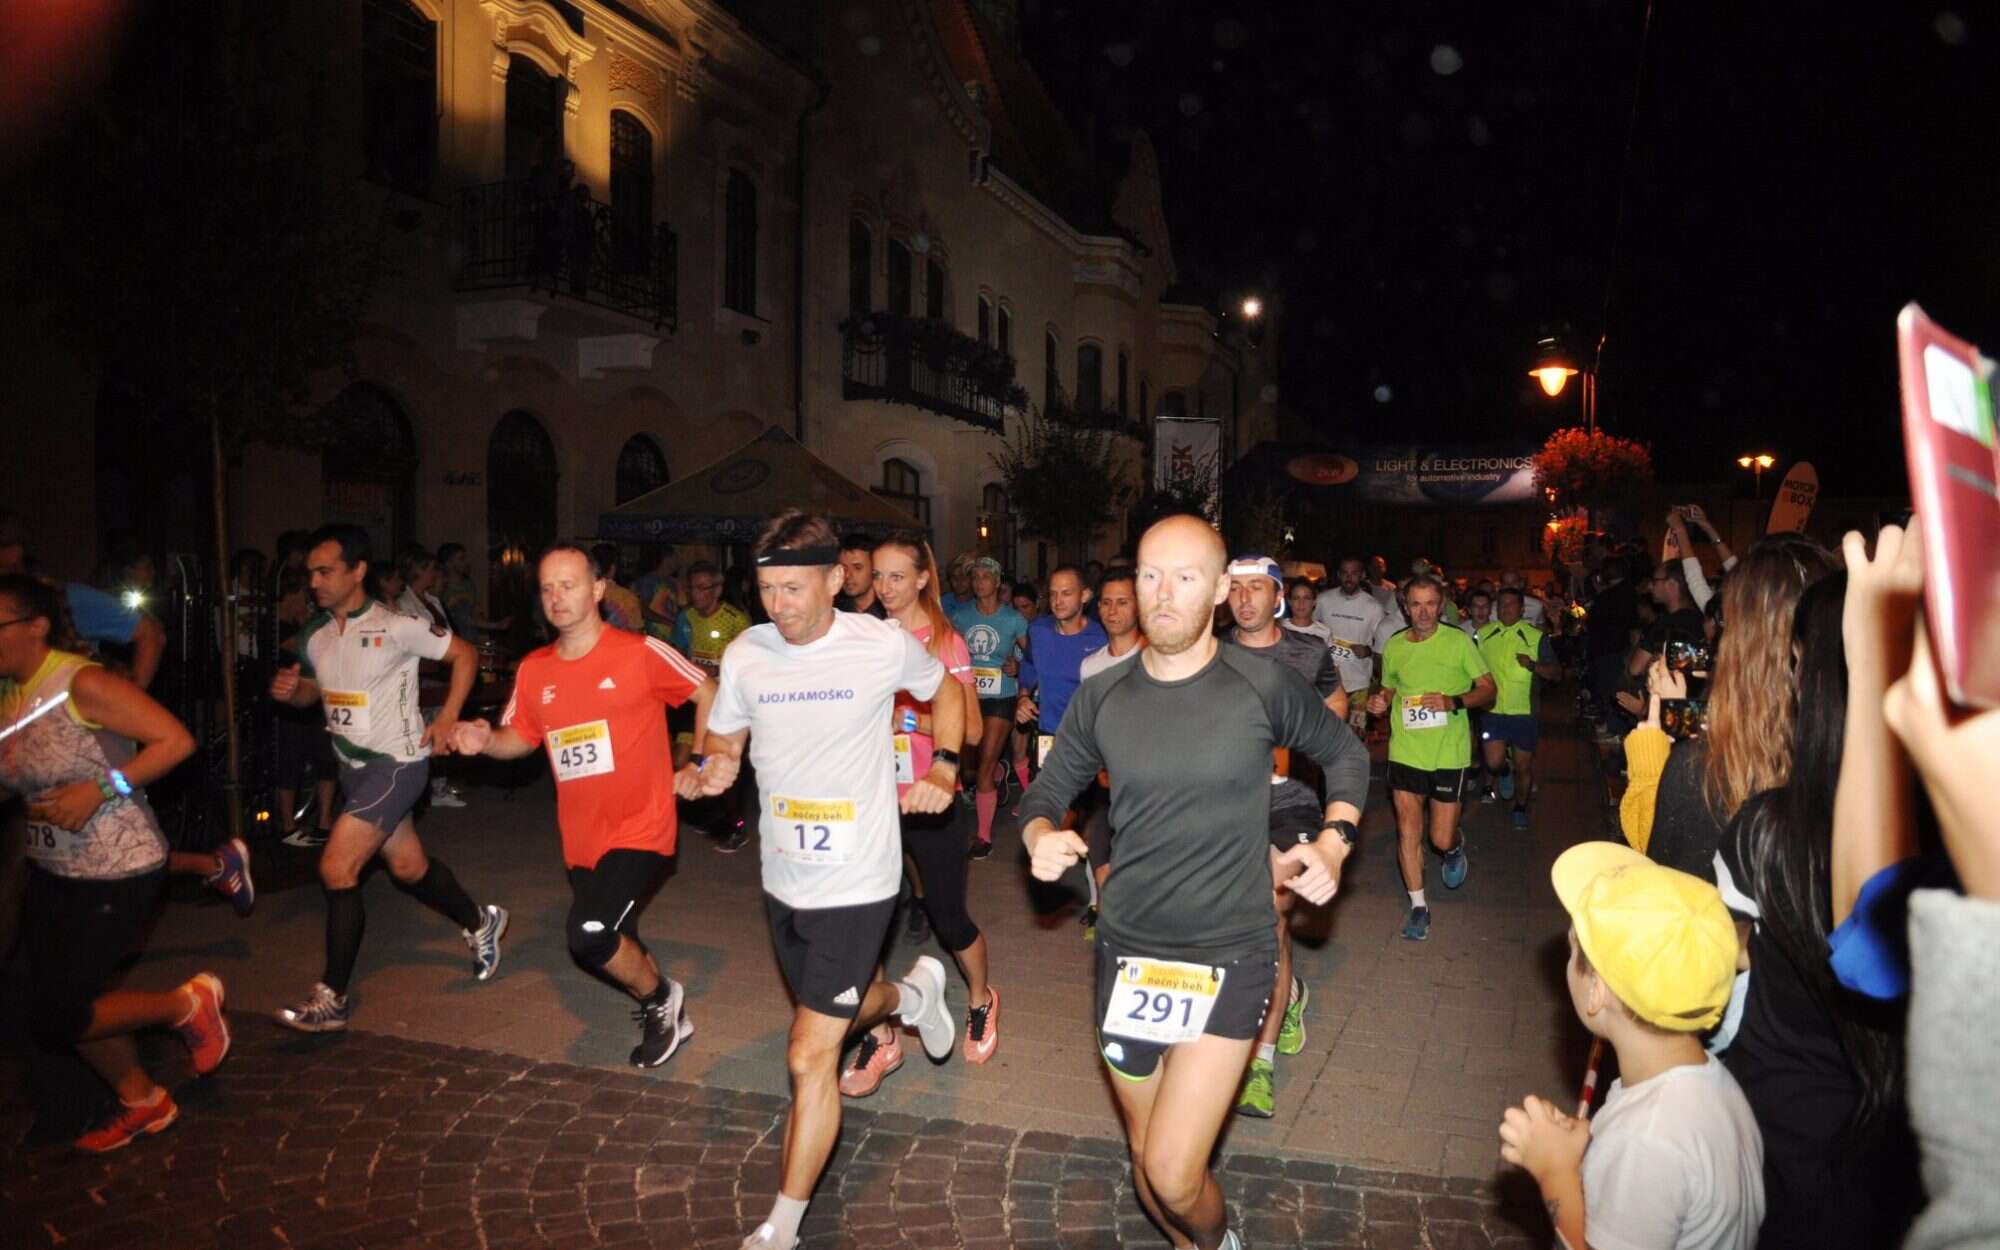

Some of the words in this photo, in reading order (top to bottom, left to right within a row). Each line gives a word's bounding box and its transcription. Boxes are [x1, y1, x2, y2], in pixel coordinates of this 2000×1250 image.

[1375, 459, 1416, 472] LIGHT
[1420, 459, 1429, 472] &
[1433, 456, 1534, 472] ELECTRONICS
[1420, 472, 1465, 483] automotive
[1466, 472, 1501, 483] industry
[1783, 480, 1816, 493] MOTOR
[331, 707, 352, 726] 42
[560, 742, 598, 768] 453
[794, 823, 832, 851] 12
[1182, 979, 1203, 992] beh
[1127, 989, 1194, 1027] 291
